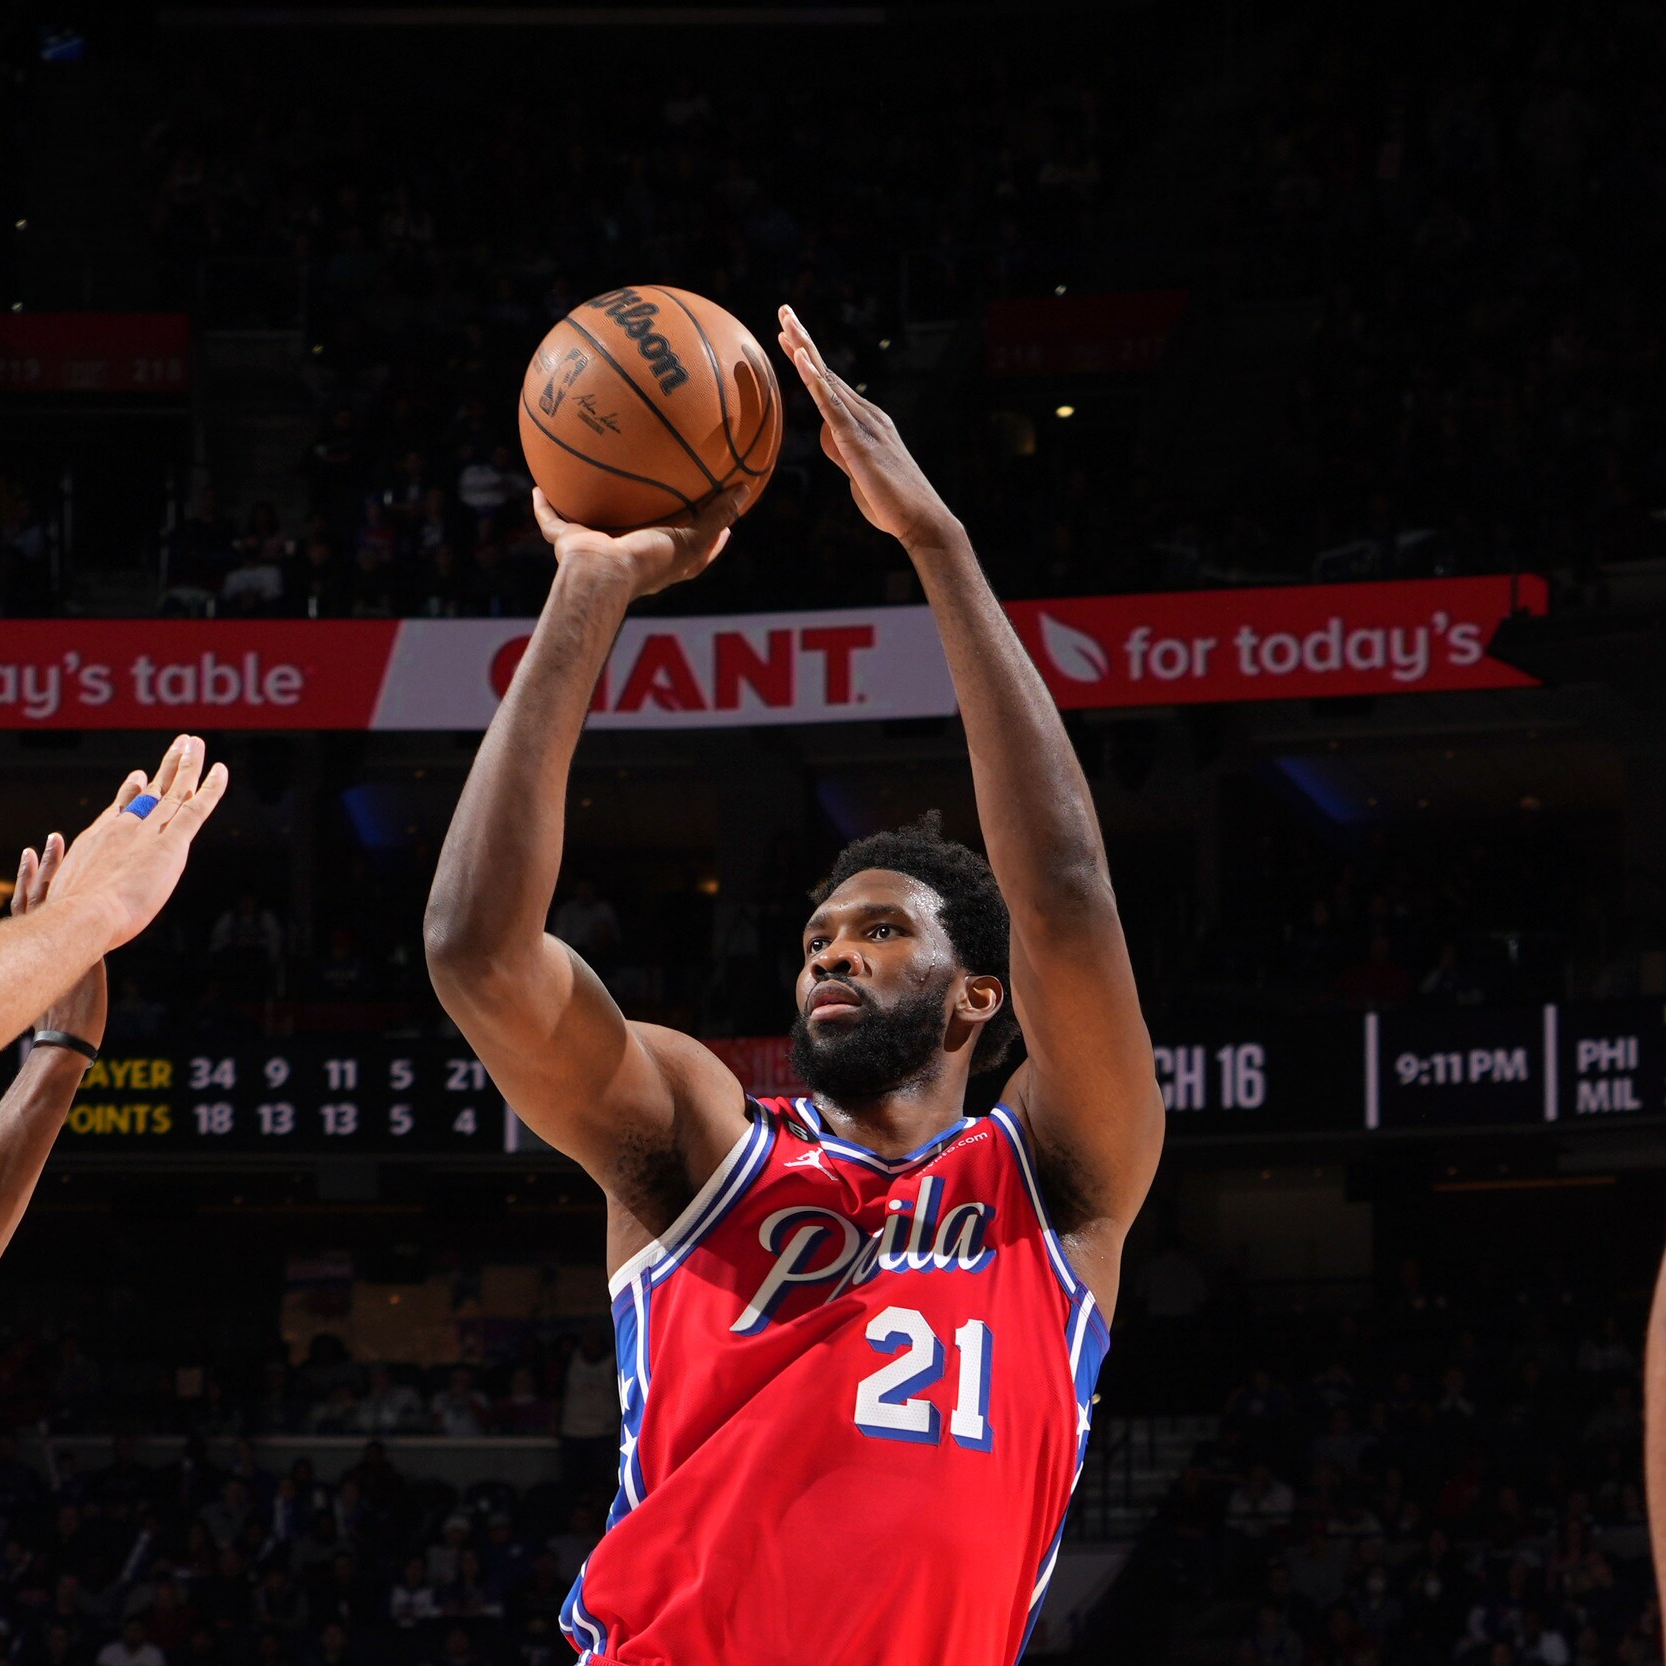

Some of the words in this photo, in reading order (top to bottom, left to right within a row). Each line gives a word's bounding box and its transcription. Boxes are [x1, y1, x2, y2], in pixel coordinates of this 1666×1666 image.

[1123, 624, 1218, 682] for
[1235, 590, 1485, 683] today's
[130, 650, 304, 707] table
[188, 1055, 237, 1091] 34
[263, 1055, 291, 1090] 9
[322, 1057, 359, 1092] 11
[388, 1057, 415, 1091] 5
[444, 1057, 487, 1092] 21
[1394, 1050, 1465, 1087] 9:11
[1467, 1044, 1529, 1084] PM
[1576, 1034, 1641, 1075] PHI
[1215, 1041, 1268, 1112] 16
[1576, 1077, 1644, 1116] MIL
[66, 1102, 174, 1136] OINTS
[192, 1102, 234, 1137] 18
[256, 1102, 296, 1137] 13
[319, 1102, 359, 1137] 13
[388, 1102, 415, 1137] 5
[451, 1104, 479, 1137] 4
[853, 1305, 993, 1453] 21
